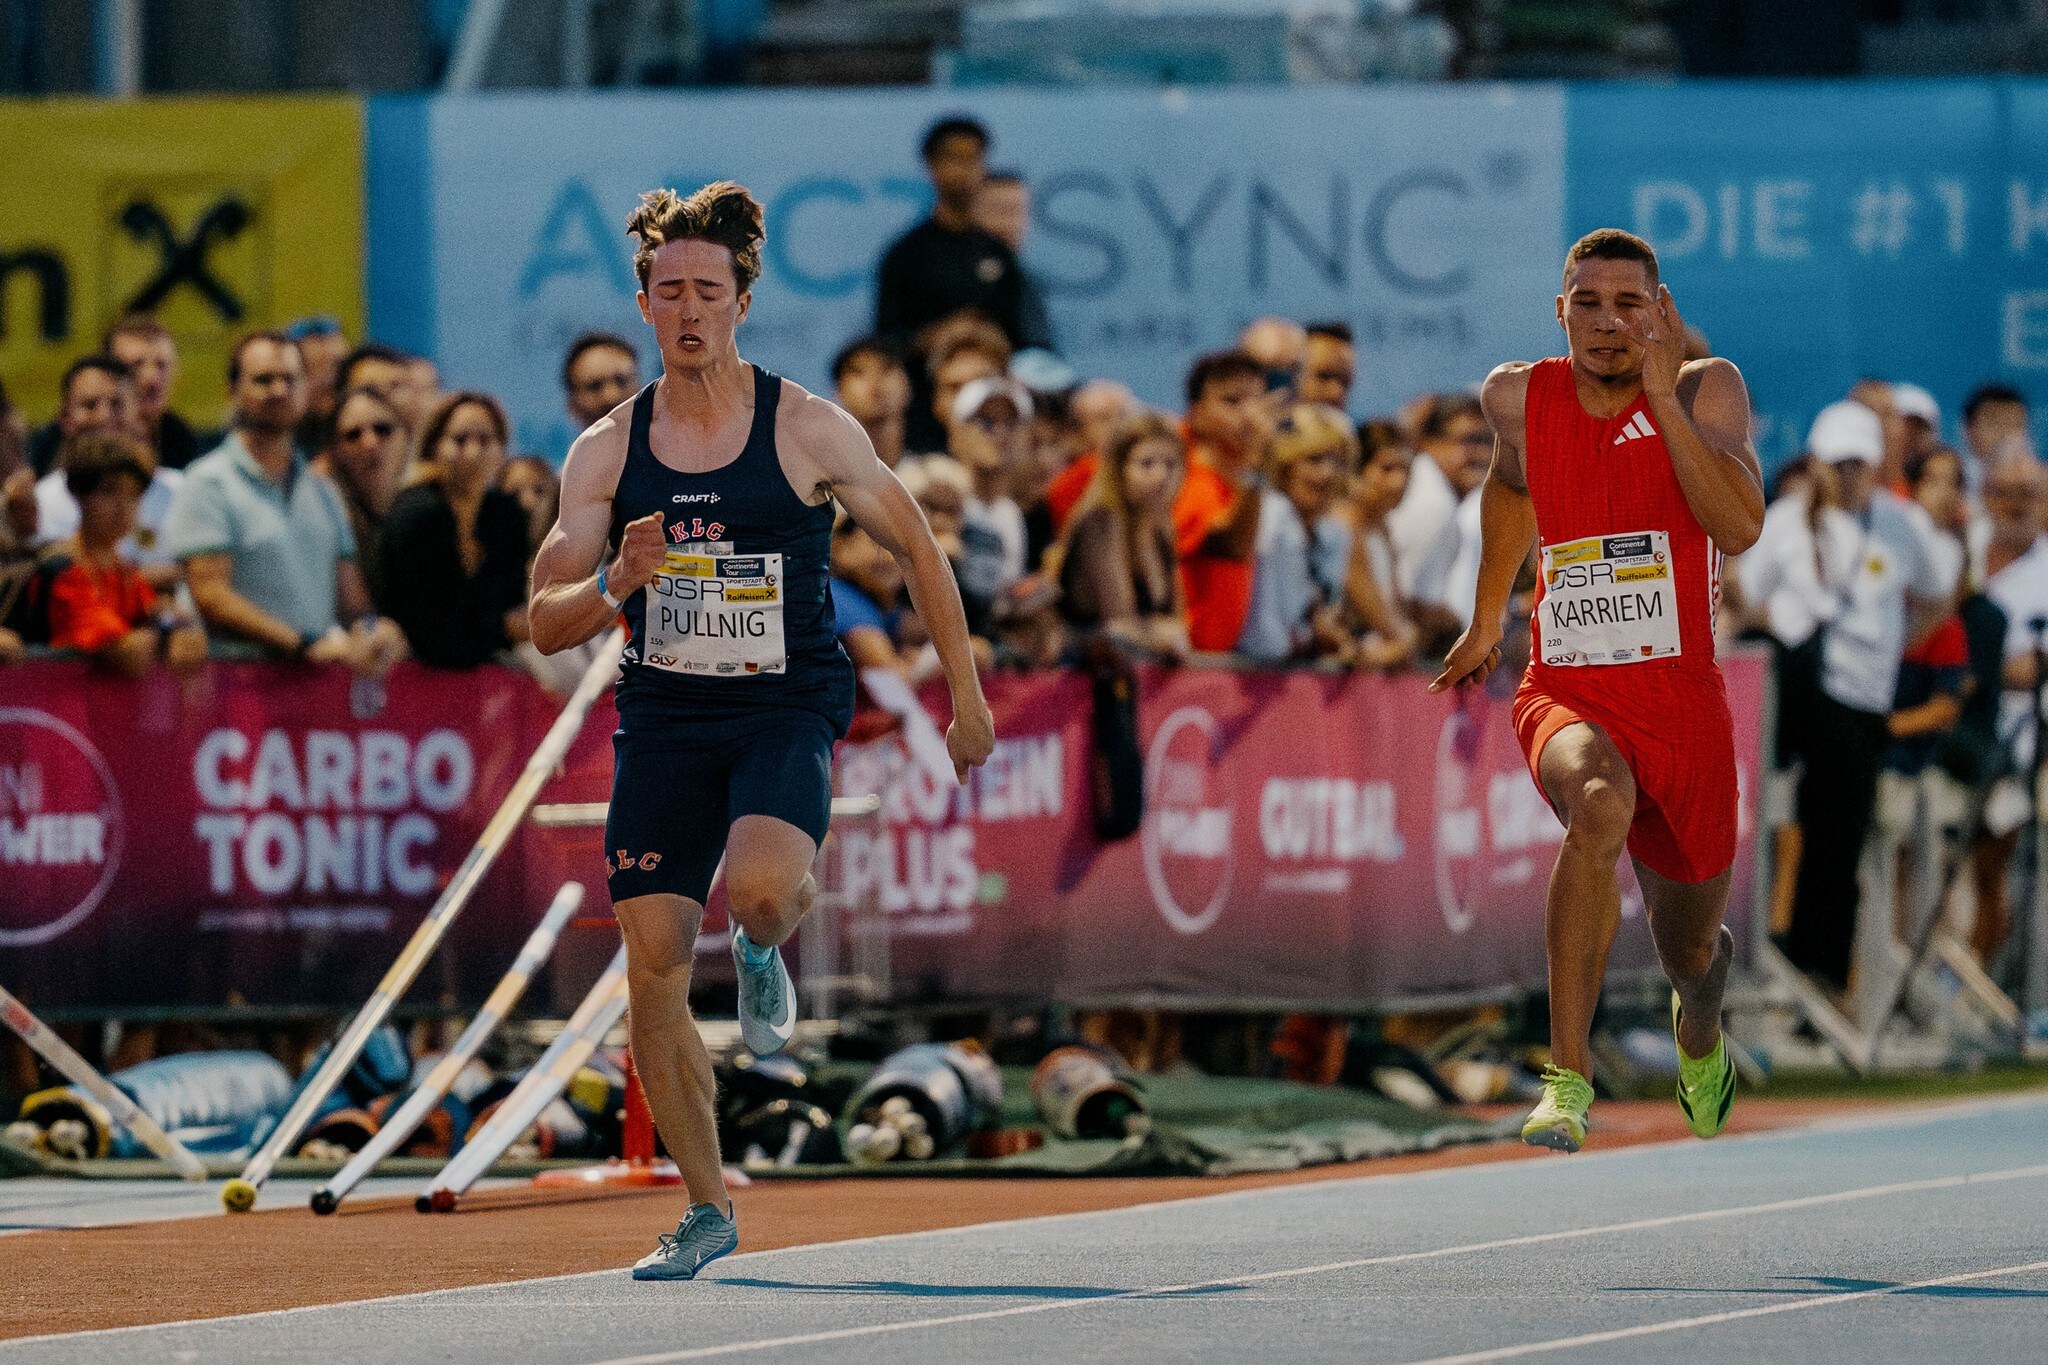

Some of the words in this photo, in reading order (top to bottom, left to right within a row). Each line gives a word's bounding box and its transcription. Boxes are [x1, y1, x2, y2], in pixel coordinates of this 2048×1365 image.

[1633, 179, 1808, 258] DIE
[672, 494, 710, 503] CRAFT
[669, 518, 726, 543] KLC
[1609, 540, 1646, 550] Continental
[1614, 556, 1650, 565] SPORTSTADT
[722, 562, 759, 570] Continental
[1616, 572, 1655, 582] Raiffeisen
[727, 592, 765, 601] Raiffeisen
[1550, 591, 1663, 629] KARRIEM
[661, 606, 765, 638] PULLNIG
[650, 637, 664, 646] 159
[1547, 638, 1562, 647] 220
[194, 728, 475, 811] CARBO
[194, 811, 441, 896] TONIC
[842, 825, 979, 911] PLUS
